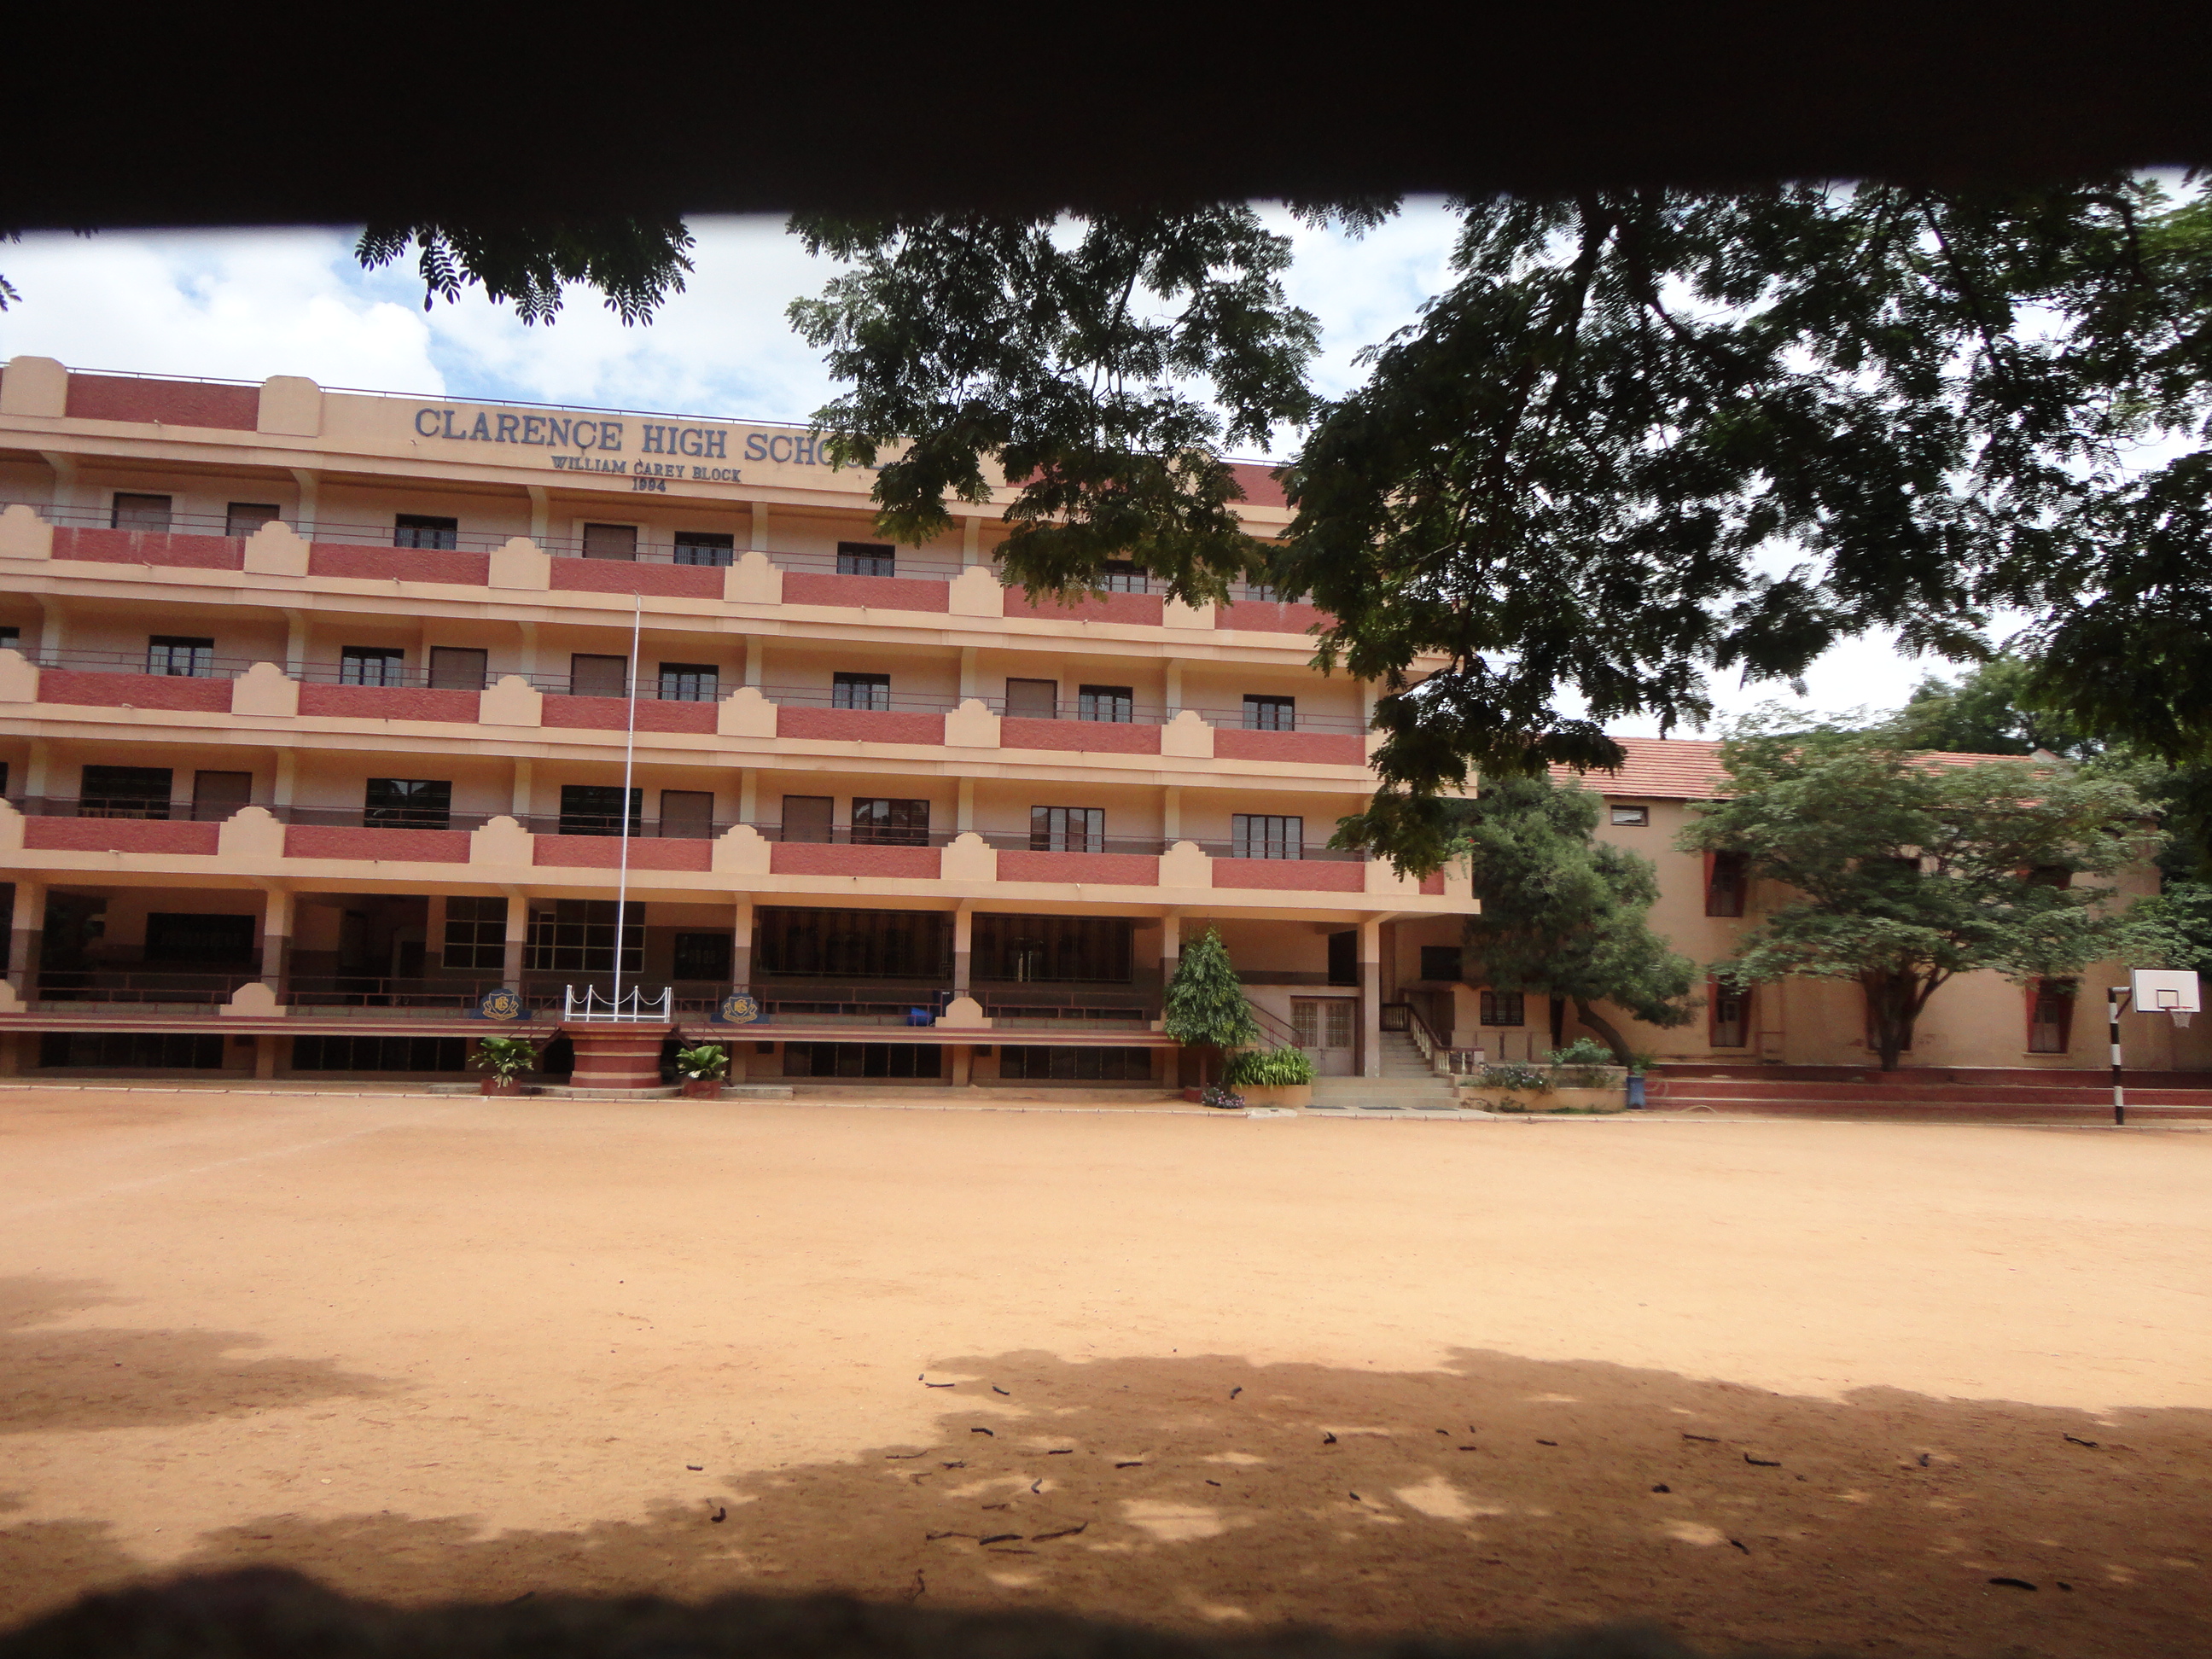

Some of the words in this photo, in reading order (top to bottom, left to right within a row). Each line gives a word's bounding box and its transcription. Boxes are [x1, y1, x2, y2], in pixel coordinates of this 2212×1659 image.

[415, 408, 623, 451] CLARENCE
[642, 425, 727, 458] HIGH
[744, 433, 890, 470] SCHO
[550, 455, 626, 474] WILLIAM
[634, 461, 685, 478] CAREY
[692, 466, 742, 481] BLOCK
[632, 477, 666, 492] 1994
